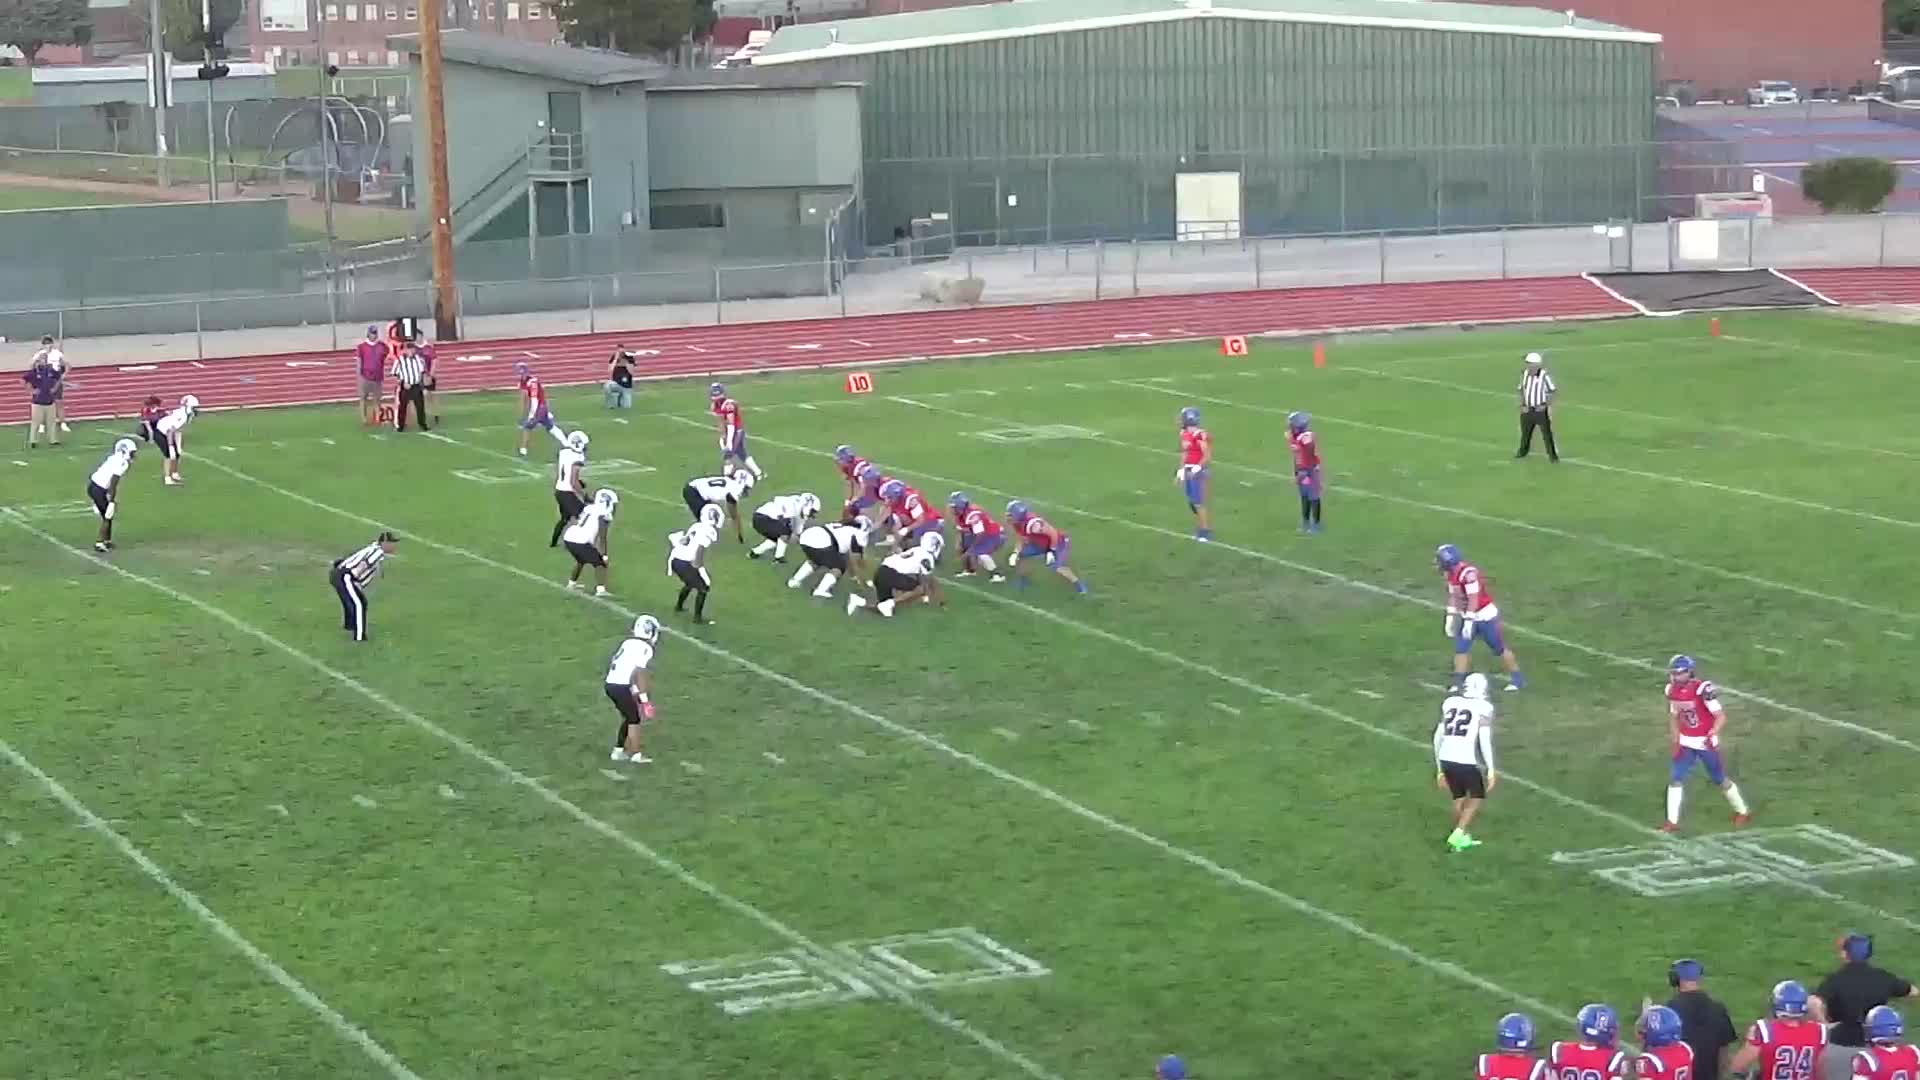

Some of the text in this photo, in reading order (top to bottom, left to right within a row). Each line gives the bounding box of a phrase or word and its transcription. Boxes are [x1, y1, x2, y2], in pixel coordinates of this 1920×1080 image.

[402, 318, 412, 337] 1
[1230, 339, 1241, 353] G
[852, 375, 869, 391] 10
[1444, 707, 1473, 738] 22
[1774, 1046, 1817, 1080] 24
